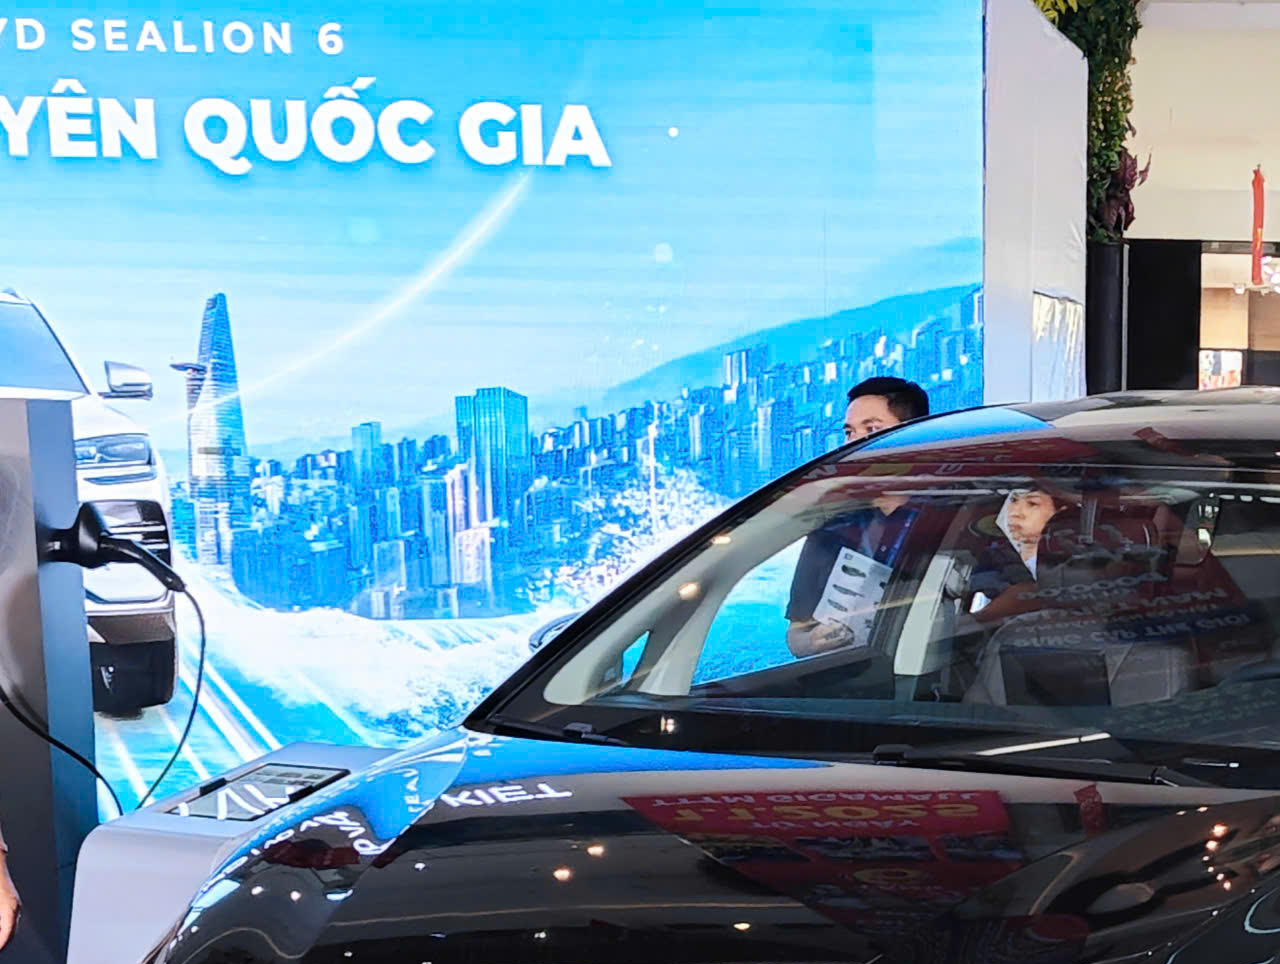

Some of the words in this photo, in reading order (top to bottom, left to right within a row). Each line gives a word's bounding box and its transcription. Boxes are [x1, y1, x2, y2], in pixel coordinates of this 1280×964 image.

[71, 18, 293, 54] SEALION
[318, 22, 344, 55] 6
[0, 78, 157, 160] YÊN
[184, 77, 436, 175] QUỐC
[459, 101, 612, 167] GIA
